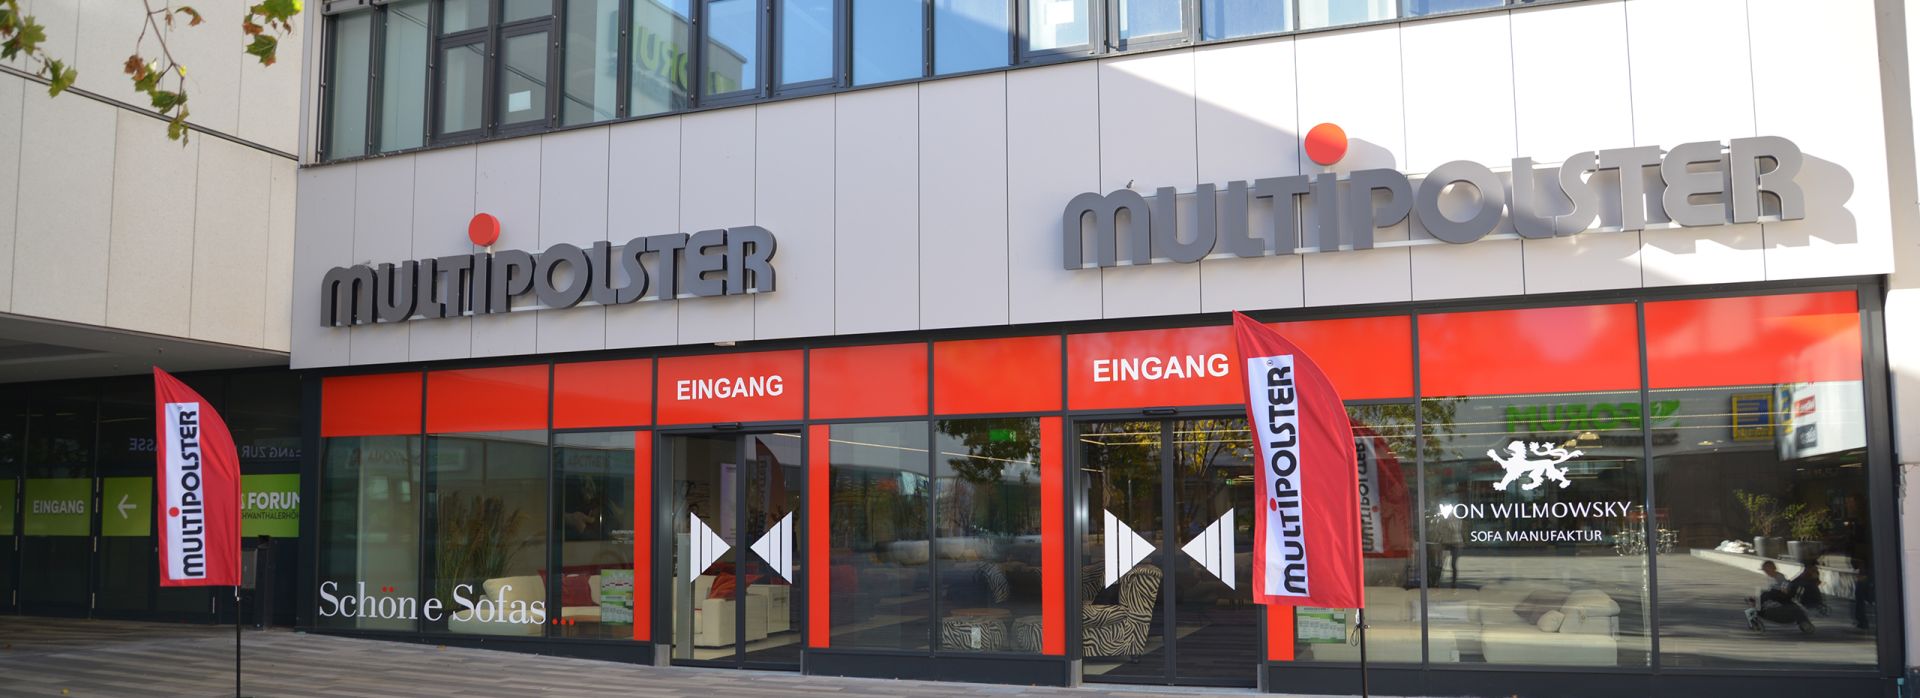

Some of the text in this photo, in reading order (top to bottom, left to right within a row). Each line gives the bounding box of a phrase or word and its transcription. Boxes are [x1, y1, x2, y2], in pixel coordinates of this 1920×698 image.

[1063, 122, 1806, 270] MULTIPOLSTER
[320, 213, 777, 327] MULTIPOLSTER
[1093, 353, 1229, 382] EINGANG
[677, 375, 783, 400] EINGANG
[170, 411, 204, 577] MULTIPOLSTER
[1267, 365, 1307, 595] MULTIPOLSTER
[33, 500, 84, 514] EINGANG
[1439, 501, 1632, 519] VON WILMOWSKY
[1470, 530, 1603, 542] SOFA MANUFAKTUR
